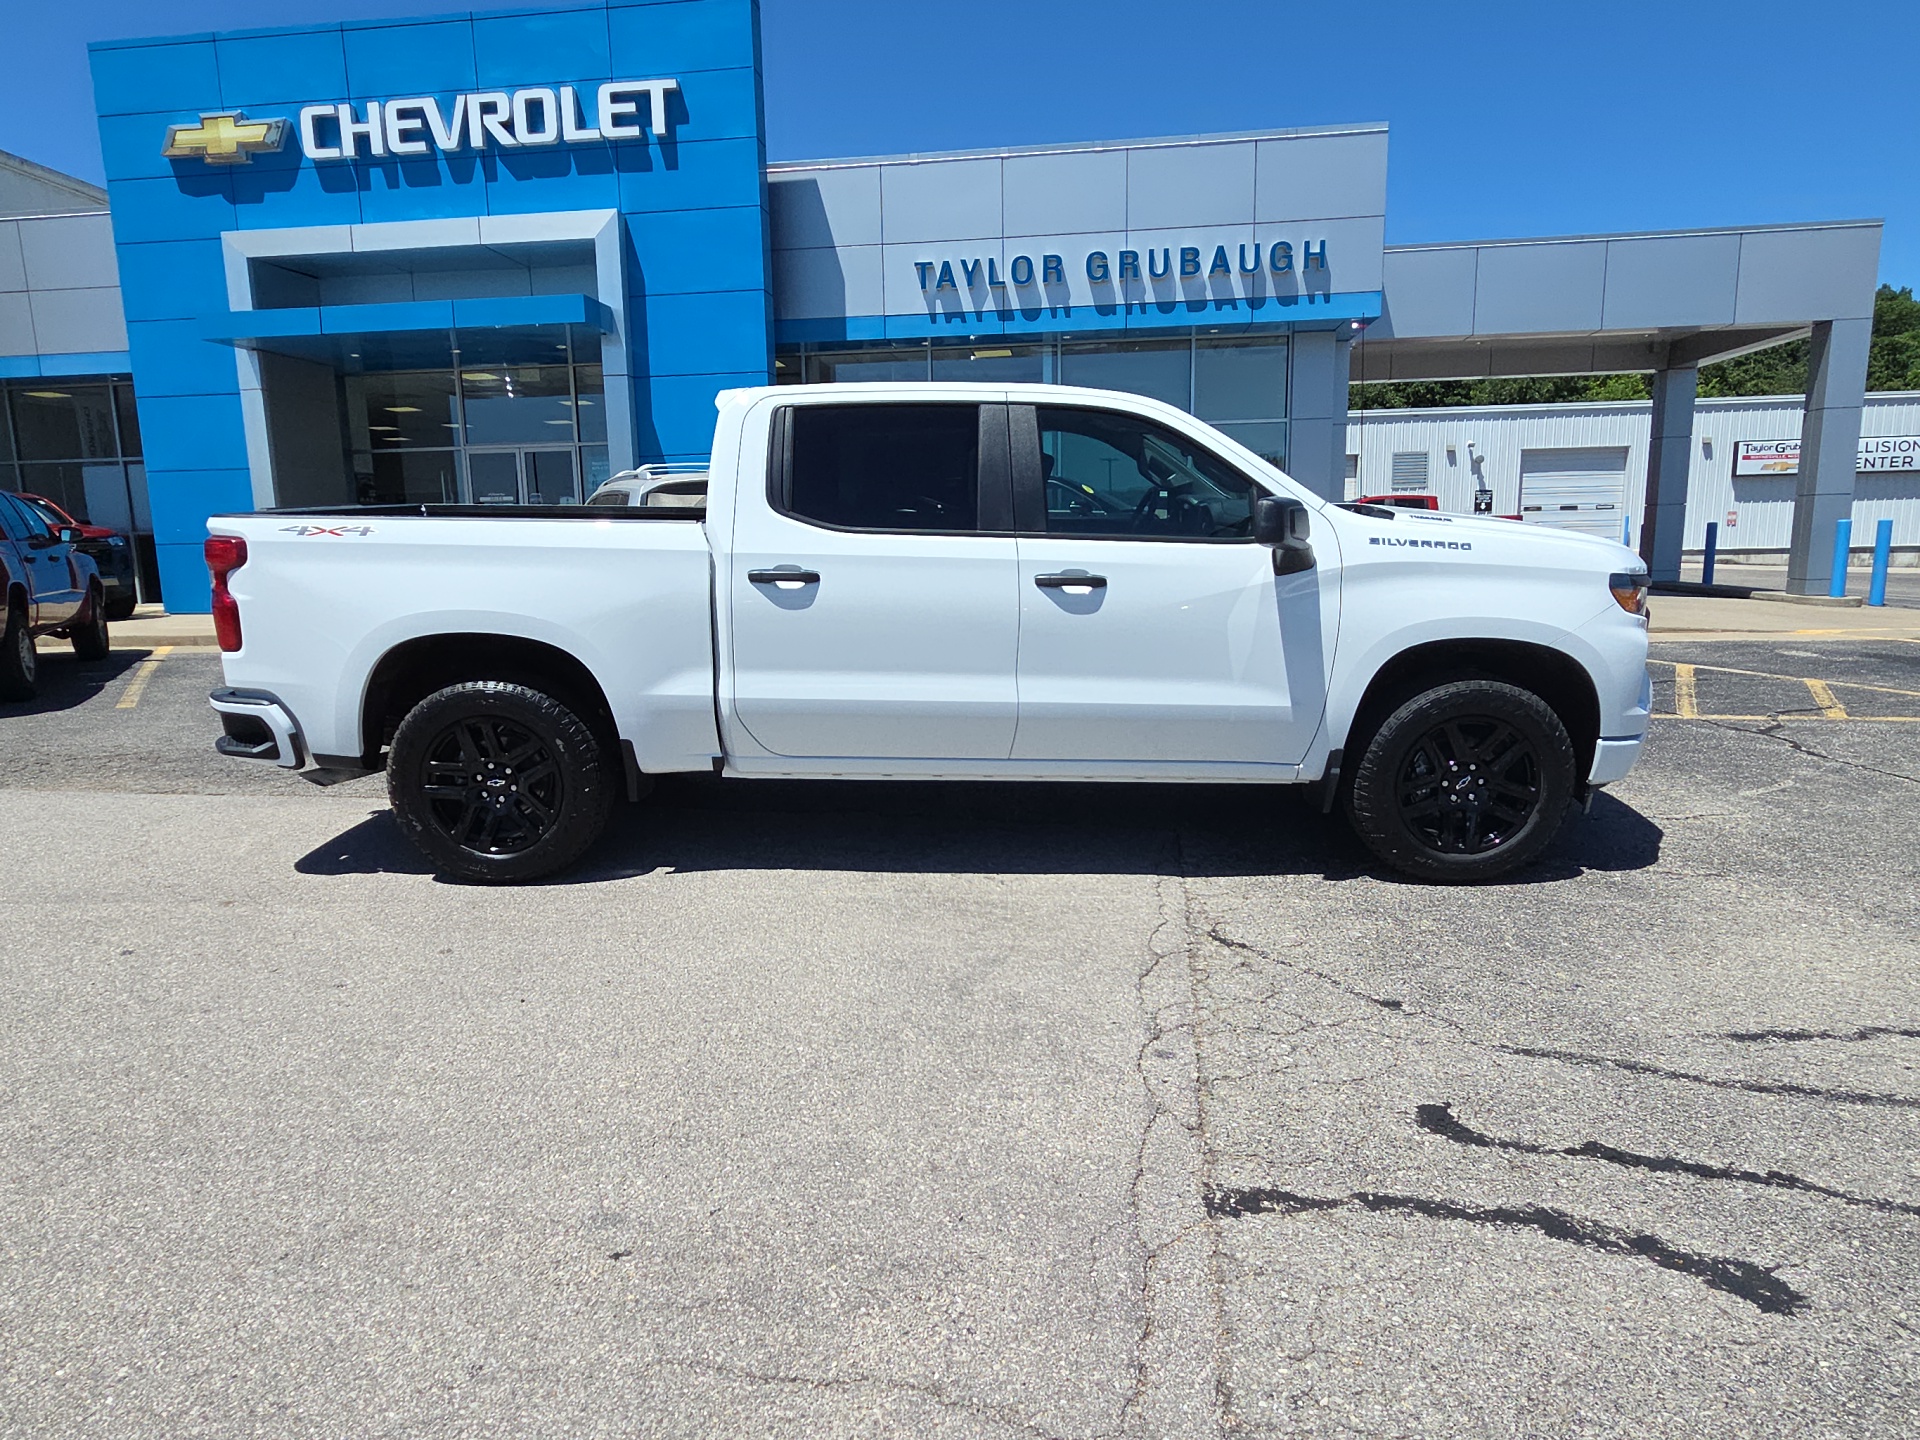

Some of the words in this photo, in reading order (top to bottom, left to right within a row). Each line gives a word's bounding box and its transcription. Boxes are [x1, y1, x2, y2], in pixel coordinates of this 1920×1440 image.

[300, 78, 678, 160] CHEVROLET
[914, 253, 1063, 290] TAYLOR
[1085, 239, 1327, 282] GRUBAUGH
[1743, 443, 1774, 454] Taylor
[1775, 442, 1801, 454] Grub
[1856, 455, 1914, 468] ENTER
[1368, 537, 1472, 551] SILVERADO
